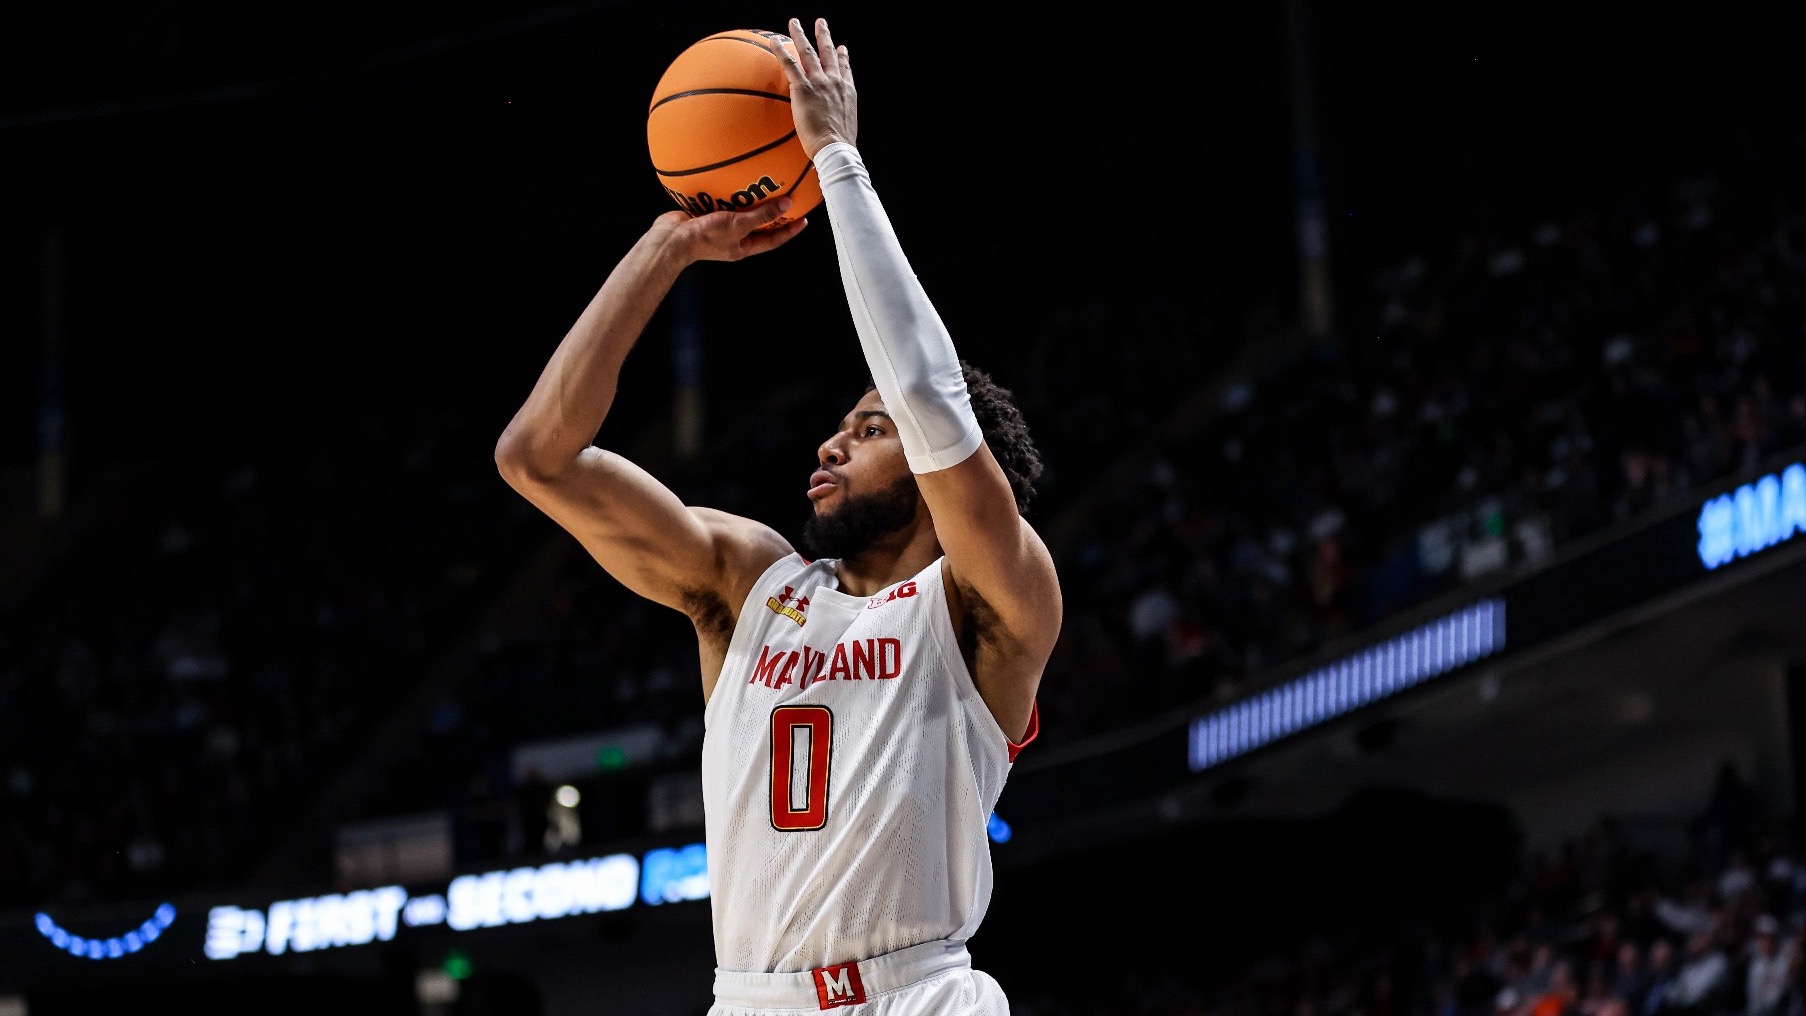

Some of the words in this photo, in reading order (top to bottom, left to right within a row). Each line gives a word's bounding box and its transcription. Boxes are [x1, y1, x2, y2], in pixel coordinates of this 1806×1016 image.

[767, 597, 807, 627] GRADUATE
[749, 637, 901, 690] MAYLAND
[769, 704, 834, 832] 0
[447, 854, 639, 931] SECOND
[821, 968, 855, 1000] M
